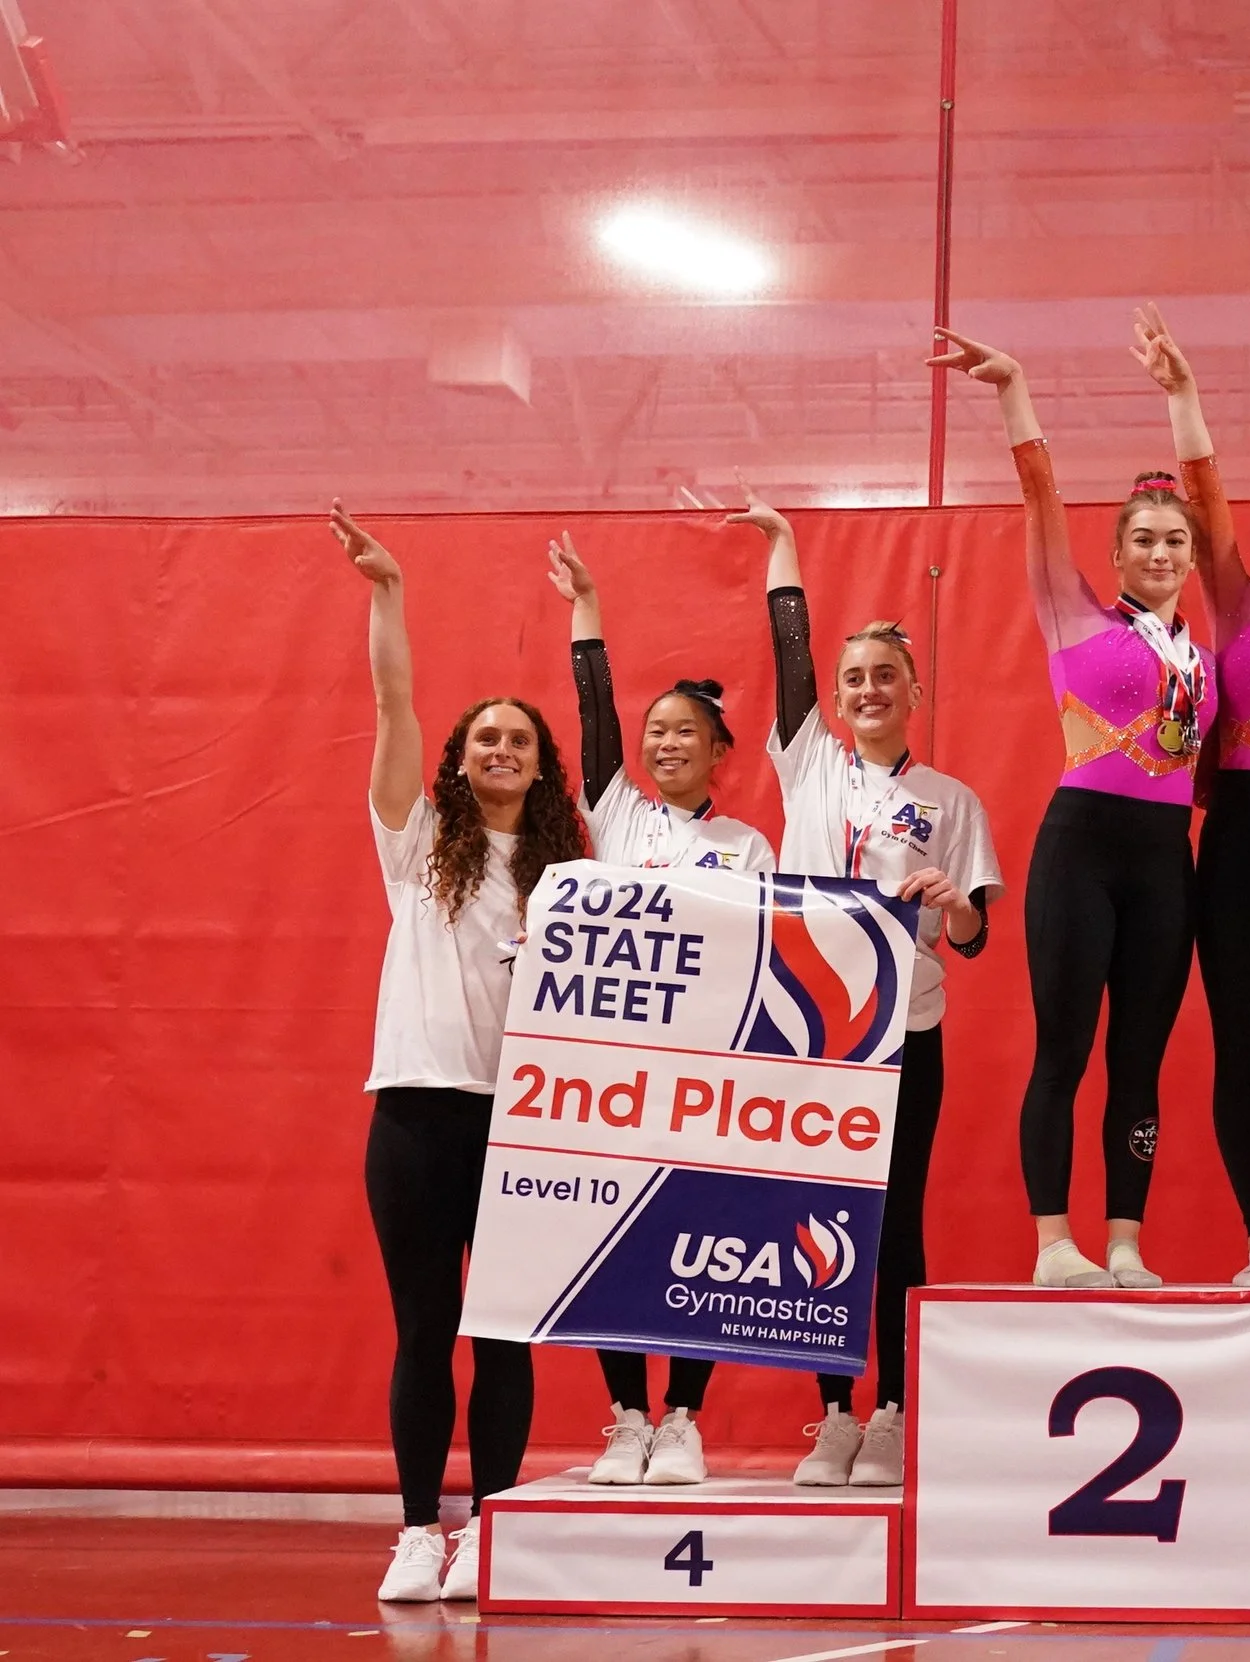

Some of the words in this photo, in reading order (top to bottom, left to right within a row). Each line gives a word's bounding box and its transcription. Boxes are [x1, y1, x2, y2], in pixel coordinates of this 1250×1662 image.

[548, 877, 674, 923] 2024
[541, 921, 704, 977] STATE
[532, 971, 687, 1025] MEET
[506, 1063, 649, 1129] 2nd
[669, 1076, 882, 1152] Place
[501, 1170, 581, 1203] Level
[590, 1178, 620, 1206] 10
[670, 1232, 782, 1287] USA
[665, 1283, 849, 1327] Gymnastics
[721, 1322, 756, 1338] NEW
[757, 1326, 847, 1347] HAMPSHIRE
[1048, 1366, 1187, 1543] 2
[664, 1530, 713, 1587] 4
